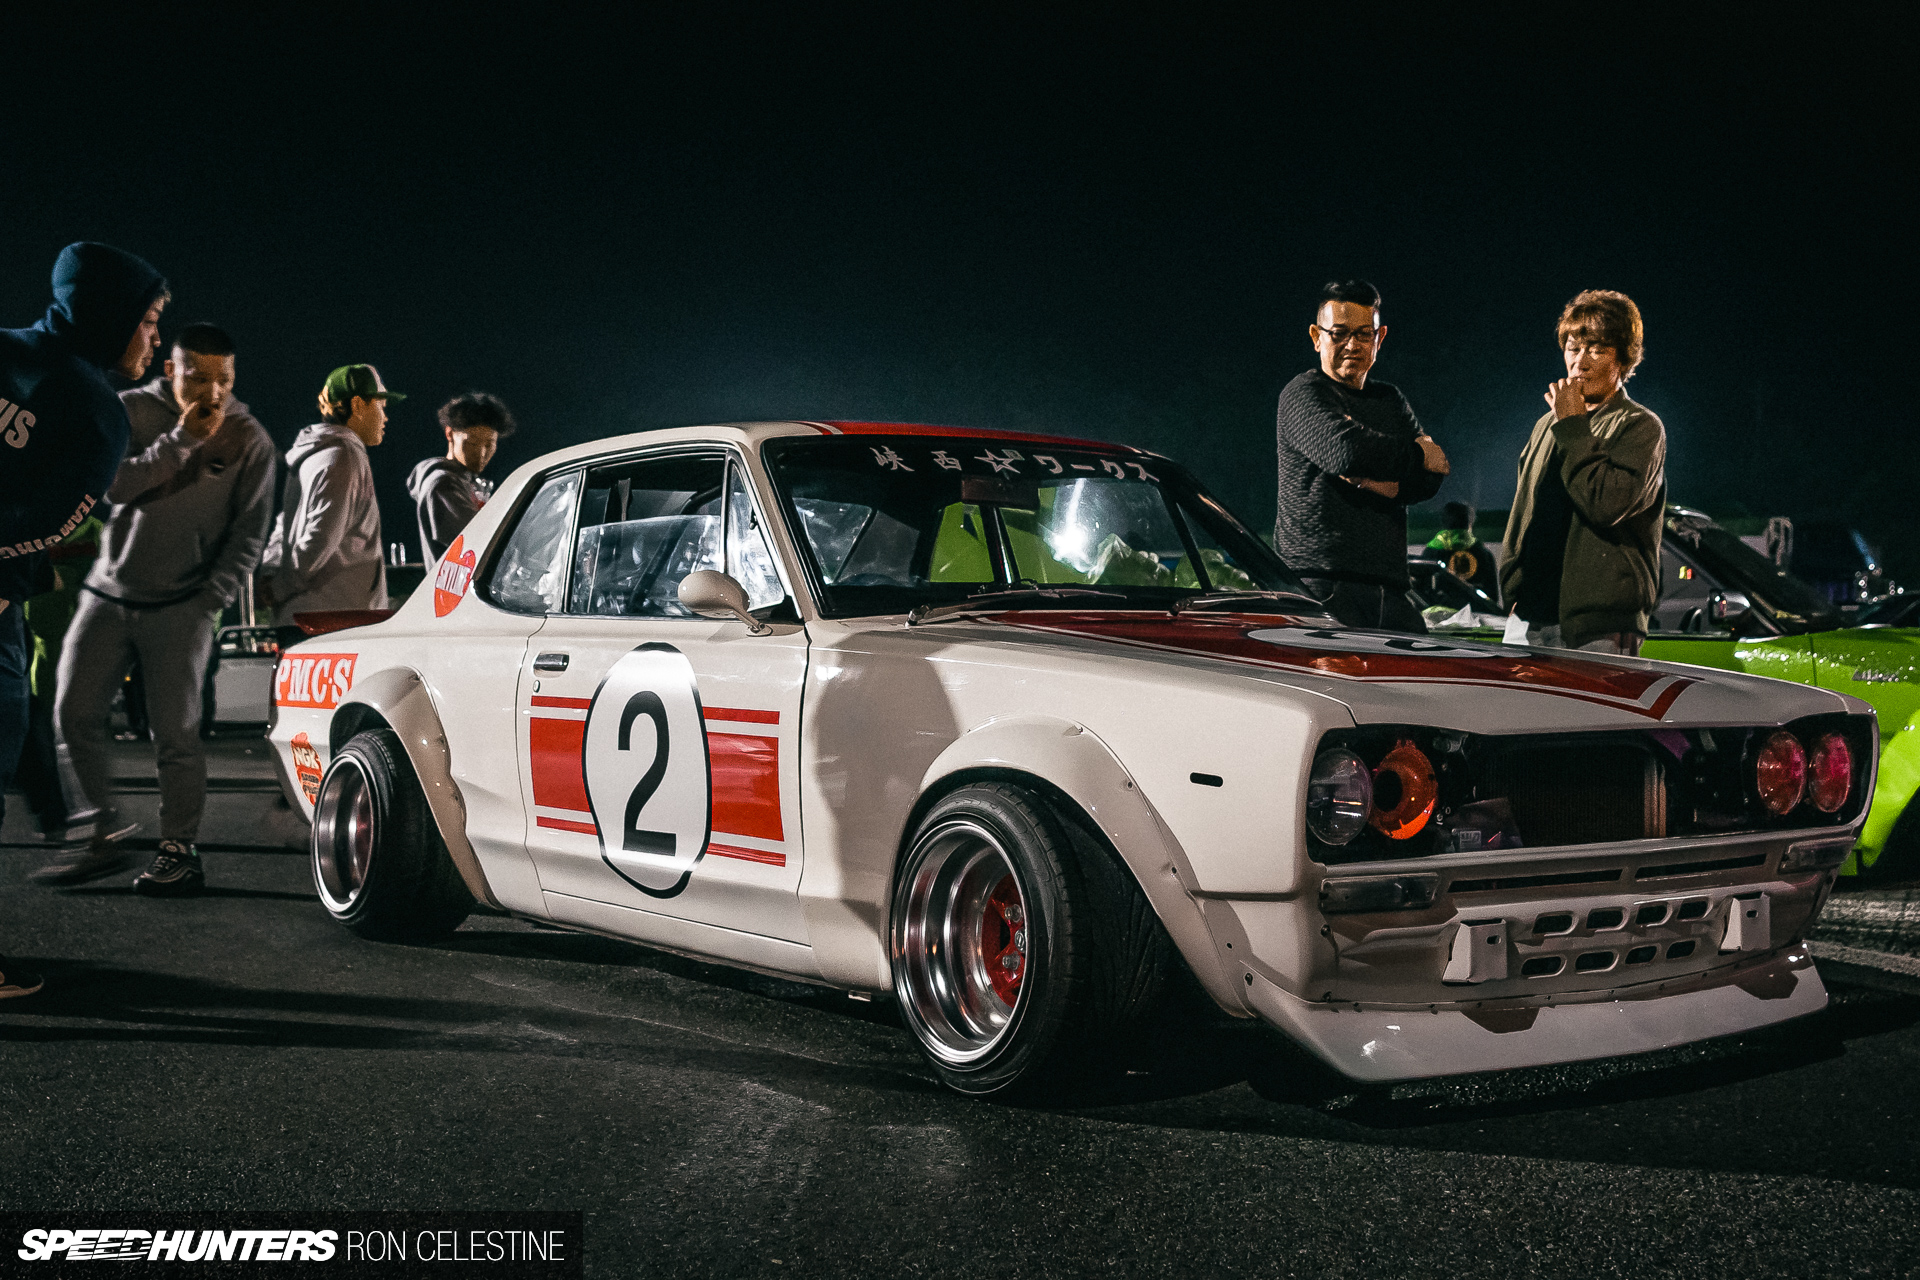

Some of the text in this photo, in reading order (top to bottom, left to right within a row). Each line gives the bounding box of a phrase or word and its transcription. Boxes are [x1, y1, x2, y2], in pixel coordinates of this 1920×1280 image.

[59, 494, 97, 537] TEAM
[293, 746, 321, 770] NGK
[618, 690, 677, 857] 2
